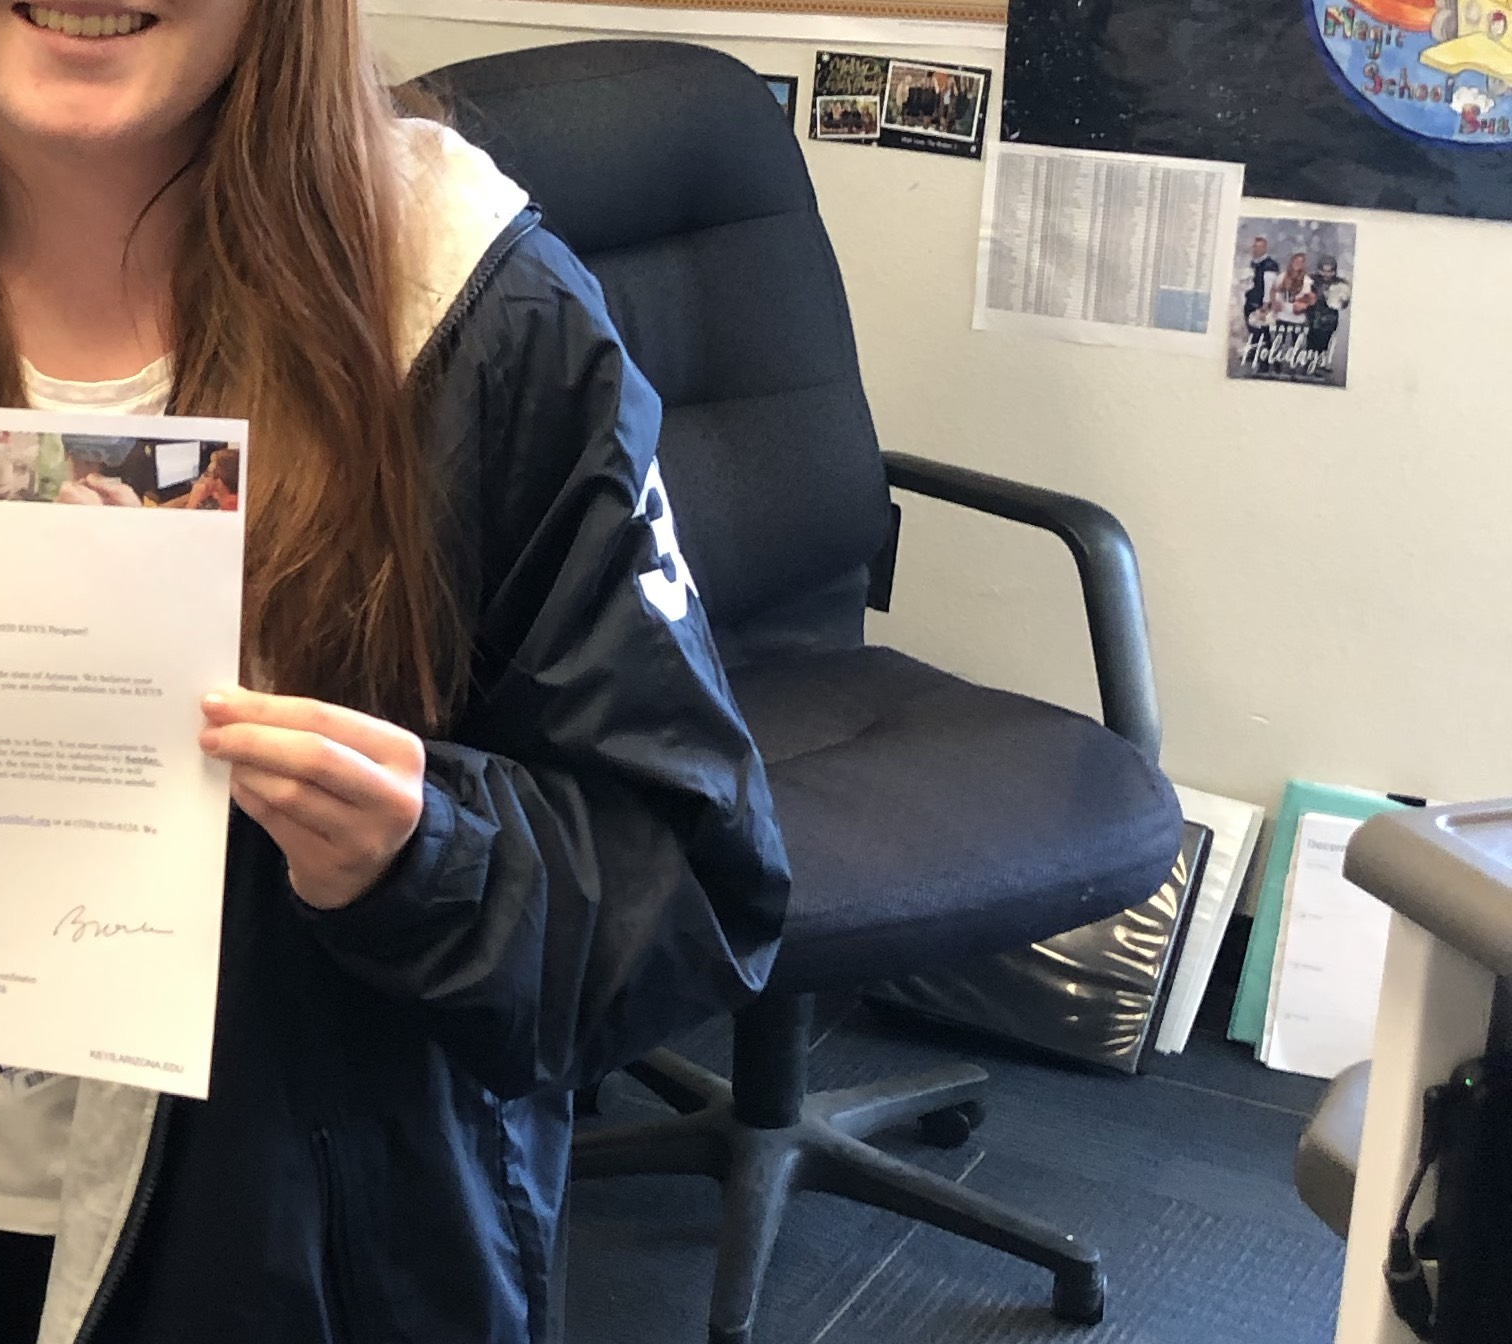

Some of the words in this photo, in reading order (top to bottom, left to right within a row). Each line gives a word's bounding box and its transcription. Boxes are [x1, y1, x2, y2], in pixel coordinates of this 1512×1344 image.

[1324, 6, 1406, 60] Magic
[1363, 61, 1456, 105] School
[1458, 102, 1512, 136] Bus
[1240, 332, 1337, 374] Holidays!
